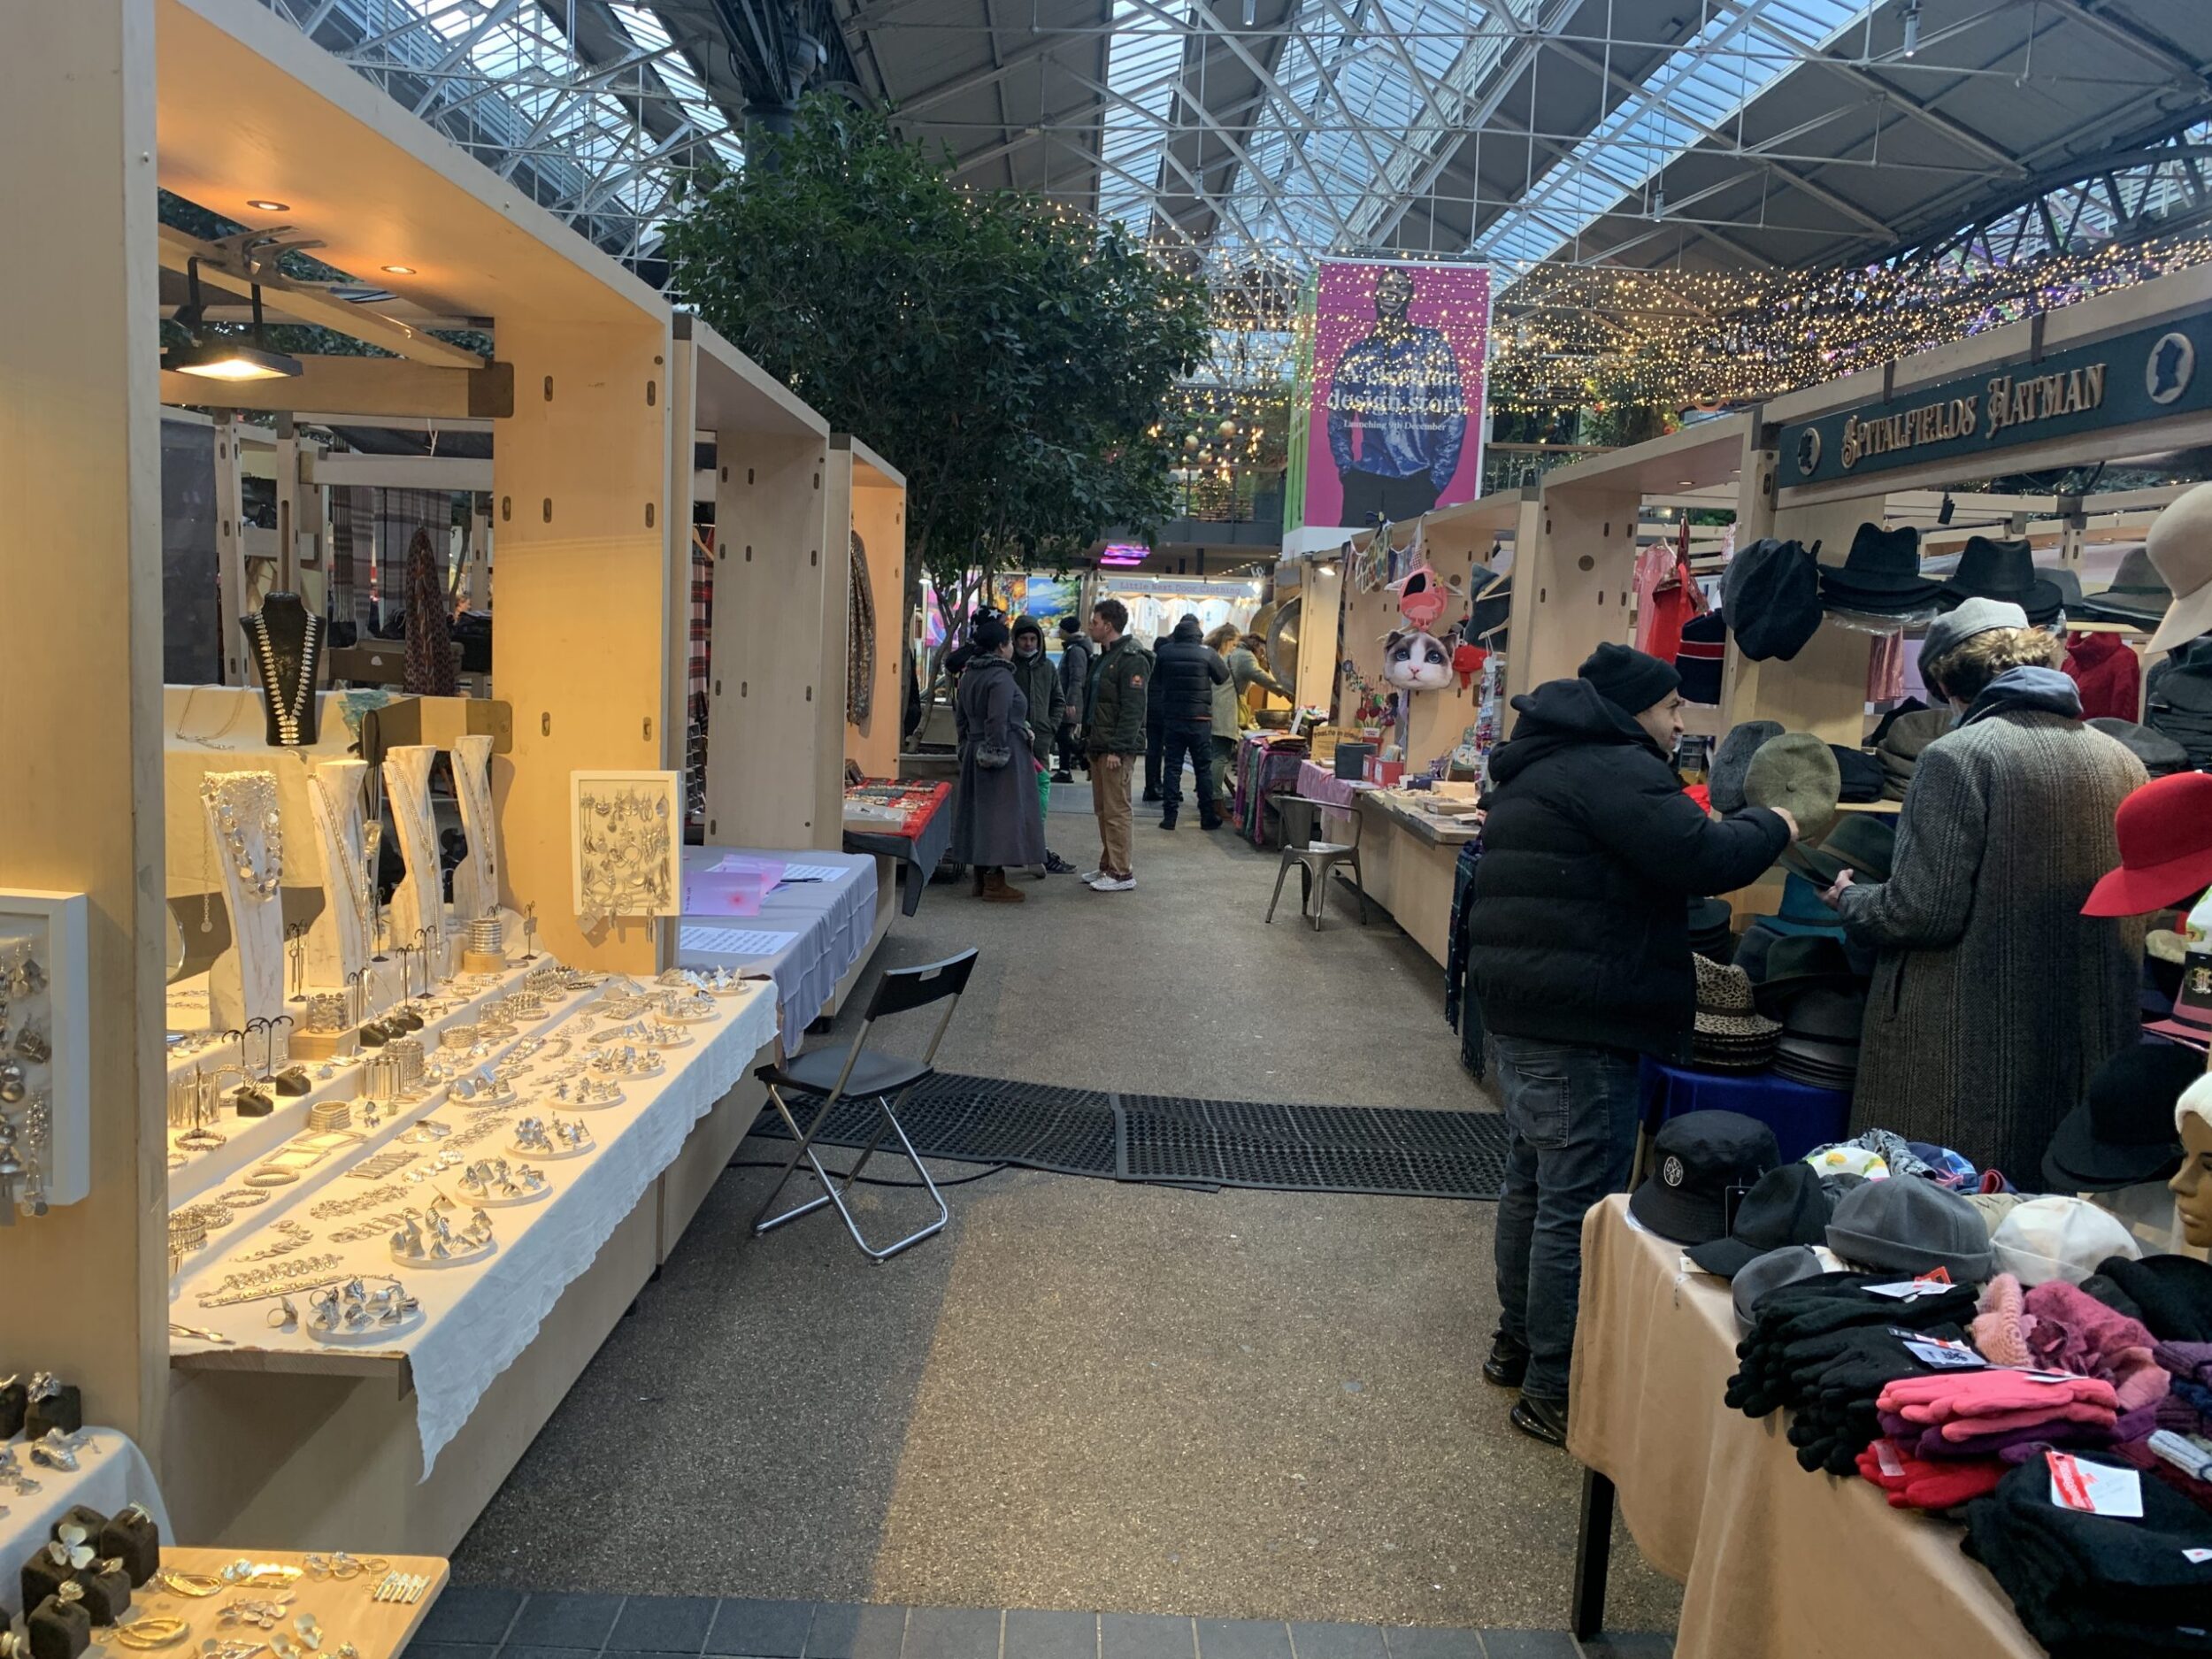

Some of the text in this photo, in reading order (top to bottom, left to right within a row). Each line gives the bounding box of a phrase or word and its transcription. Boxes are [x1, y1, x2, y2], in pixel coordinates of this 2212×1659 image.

[1340, 364, 1458, 387] A circular
[1326, 388, 1467, 419] design story
[1343, 419, 1448, 432] Launching 9th December
[1119, 580, 1148, 590] Little
[1200, 584, 1241, 595] Clothing
